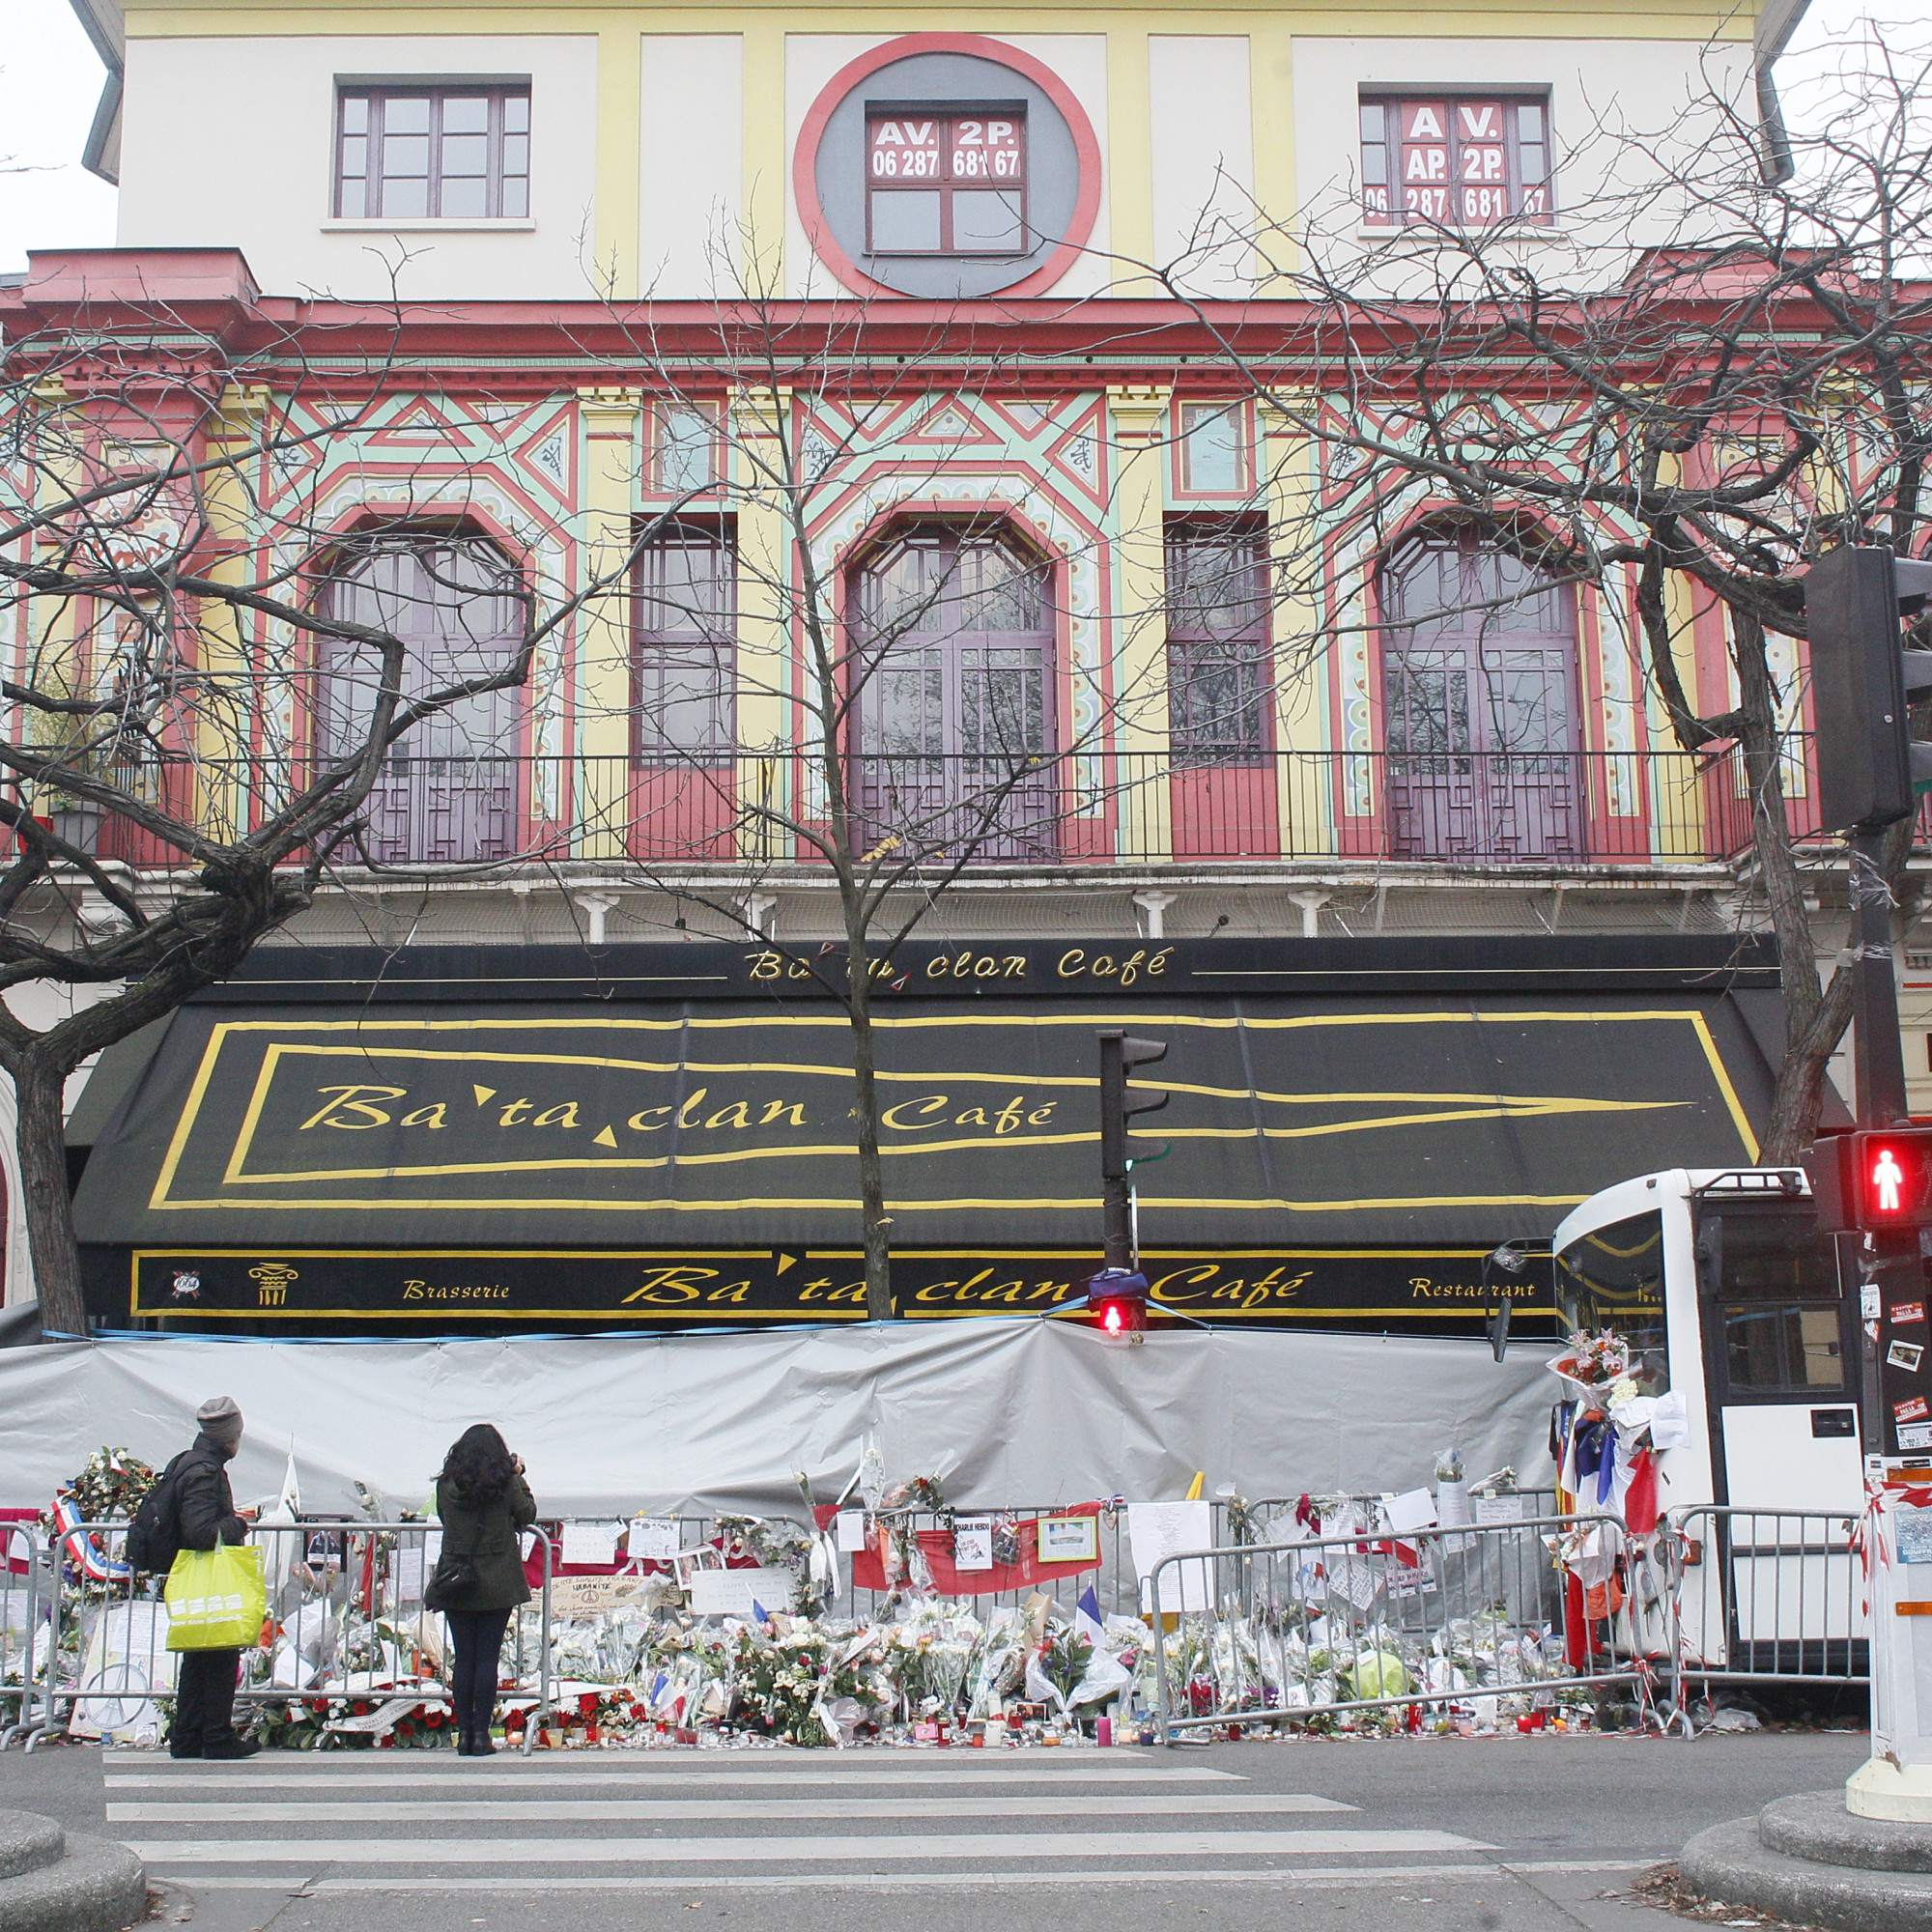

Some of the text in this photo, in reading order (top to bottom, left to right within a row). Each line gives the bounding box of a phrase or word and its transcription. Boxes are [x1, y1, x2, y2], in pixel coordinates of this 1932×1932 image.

[876, 122, 1014, 145] AV. 2P.
[872, 150, 1019, 176] 06 287 681 67
[1406, 149, 1502, 180] AP. 2P.
[1406, 188, 1446, 218] 287
[1464, 188, 1502, 218] 681
[1057, 947, 1176, 986] Café
[882, 1095, 1058, 1134] Café
[402, 1279, 510, 1299] Brasserie
[1149, 1264, 1314, 1308] Café
